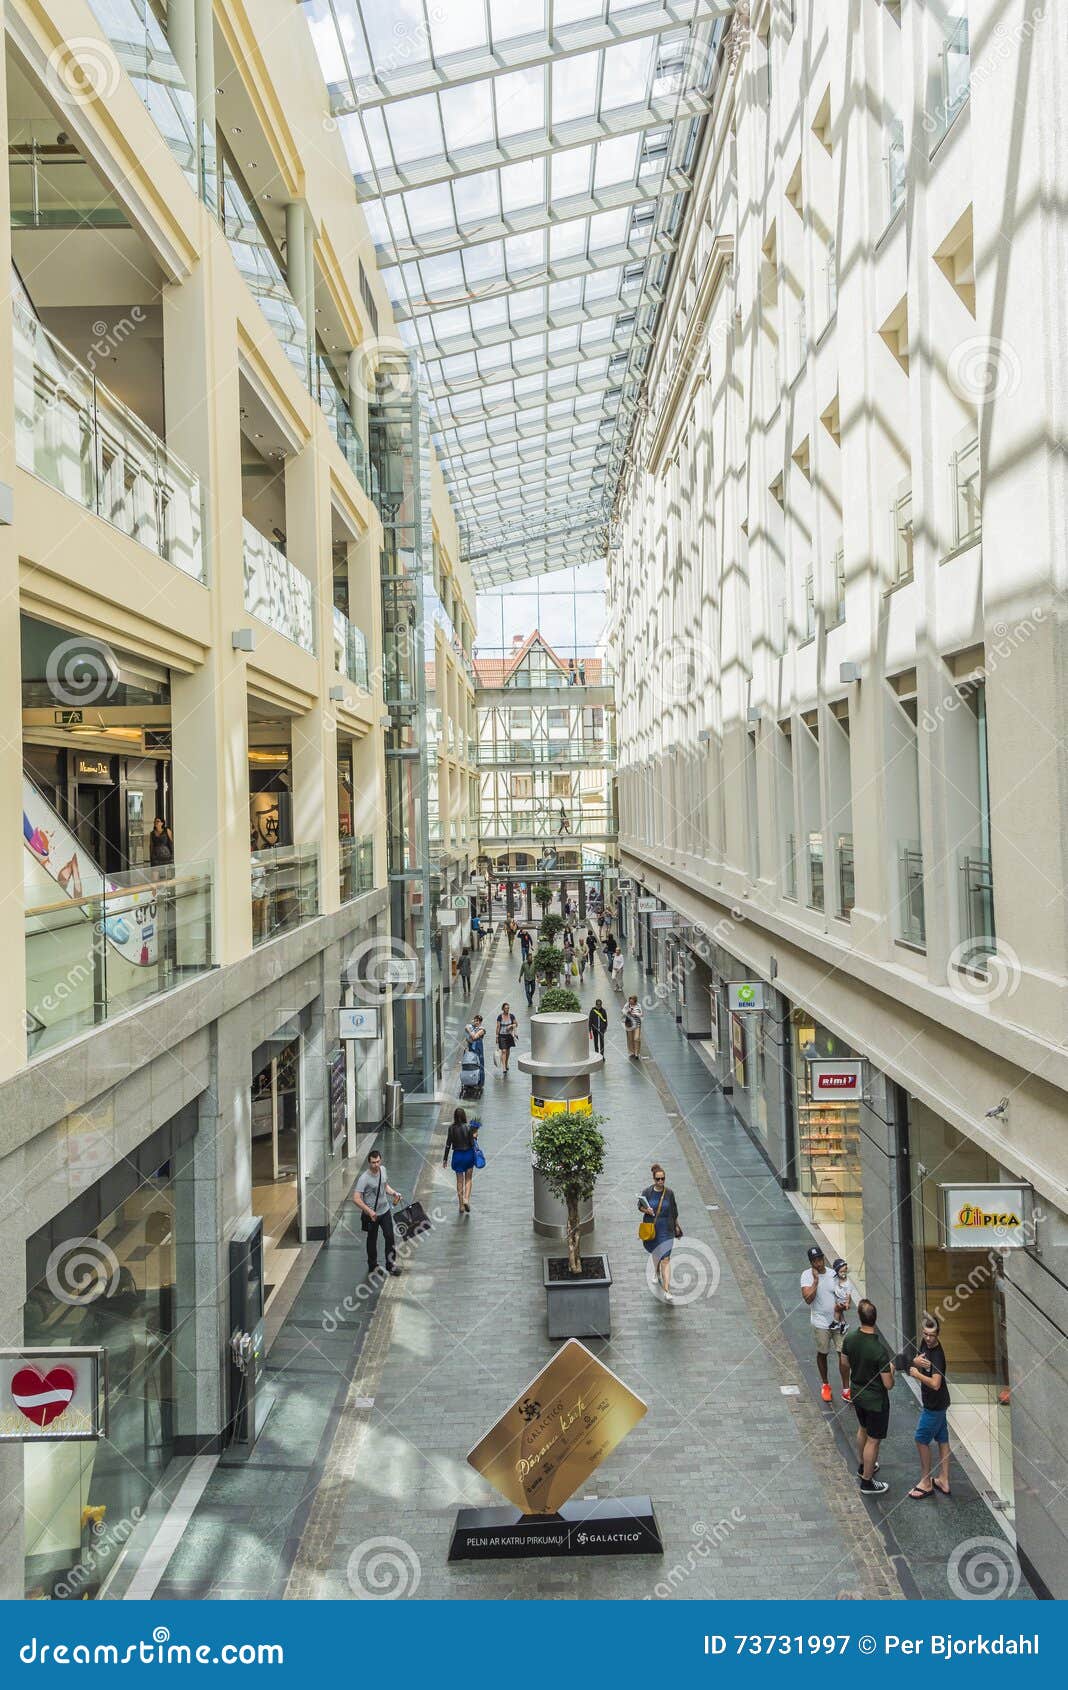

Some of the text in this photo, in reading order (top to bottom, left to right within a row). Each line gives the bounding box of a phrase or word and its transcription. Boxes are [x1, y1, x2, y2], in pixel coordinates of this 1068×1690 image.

[526, 1402, 564, 1444] GALACTICO
[467, 1537, 488, 1546] PELNI
[489, 1536, 501, 1546] AR
[501, 1536, 526, 1546] KATRU
